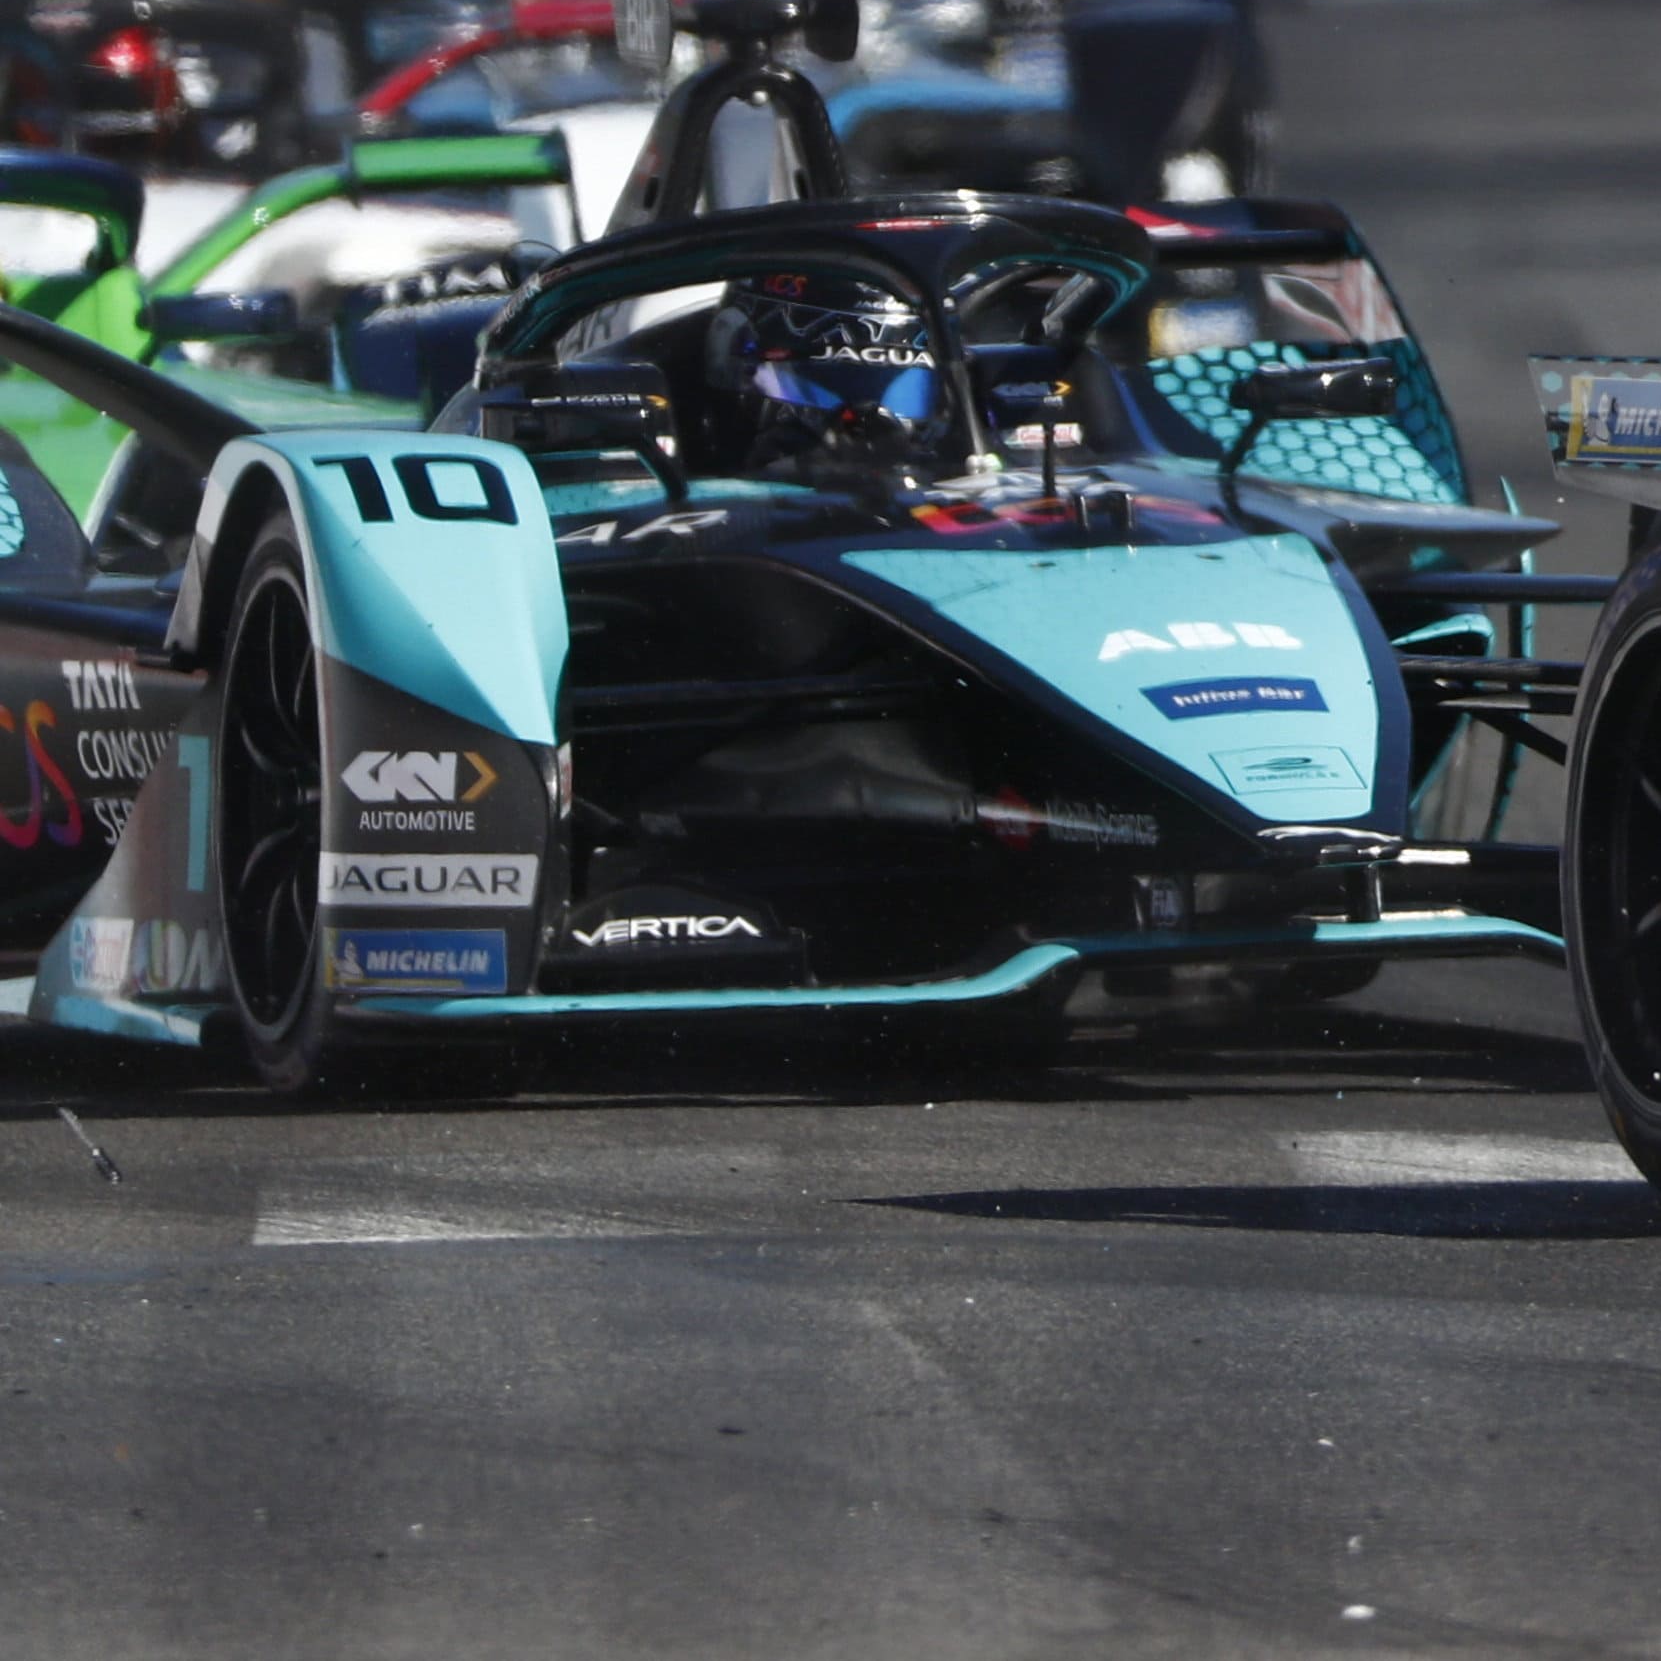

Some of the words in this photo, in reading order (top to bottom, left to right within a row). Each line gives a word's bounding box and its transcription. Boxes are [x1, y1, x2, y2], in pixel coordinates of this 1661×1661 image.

[810, 345, 936, 368] JAGUA
[311, 454, 519, 525] 10
[1097, 621, 1302, 662] ABB
[61, 660, 141, 710] TATA
[359, 811, 476, 831] AUTOMOTIVE
[330, 866, 521, 894] JAGUAR
[572, 916, 762, 947] VERTICA
[366, 951, 489, 972] MICHELIN
